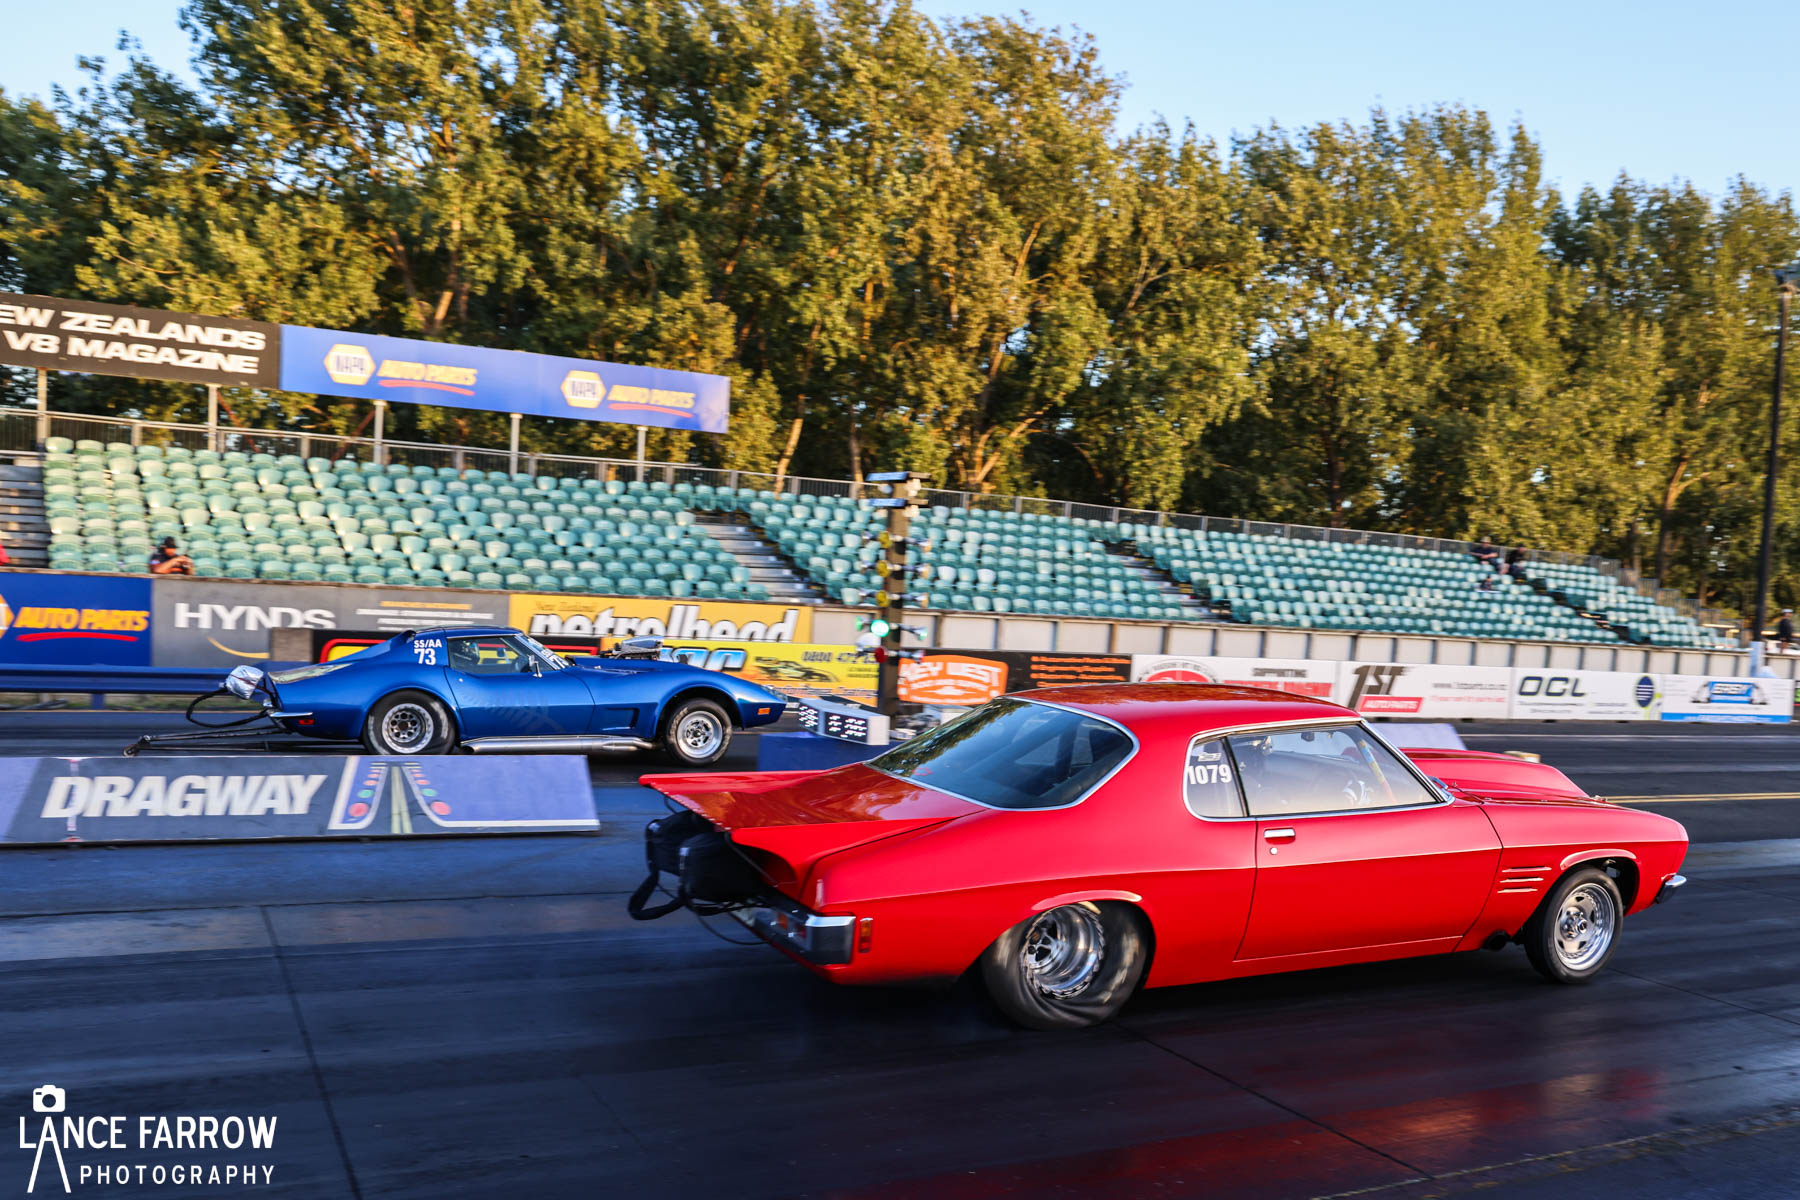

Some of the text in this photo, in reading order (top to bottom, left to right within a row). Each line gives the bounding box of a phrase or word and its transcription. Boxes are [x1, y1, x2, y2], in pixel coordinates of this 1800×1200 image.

[59, 310, 267, 350] ZEALANDS
[2, 330, 260, 374] V8 MAGAZINE
[376, 359, 425, 380] AUTO
[425, 364, 478, 386] PARTS
[607, 384, 650, 403] AUTO
[650, 389, 696, 408] PARTS
[13, 606, 150, 631] AUTO PARTS
[174, 602, 337, 631] HYNDS
[413, 638, 442, 648] SS/AA
[413, 648, 436, 665] 73
[946, 661, 1002, 687] WEST
[1518, 676, 1586, 697] OCL
[1348, 665, 1406, 710] 1ST
[1188, 763, 1232, 785] 1079
[41, 774, 328, 819] DRAGWAY
